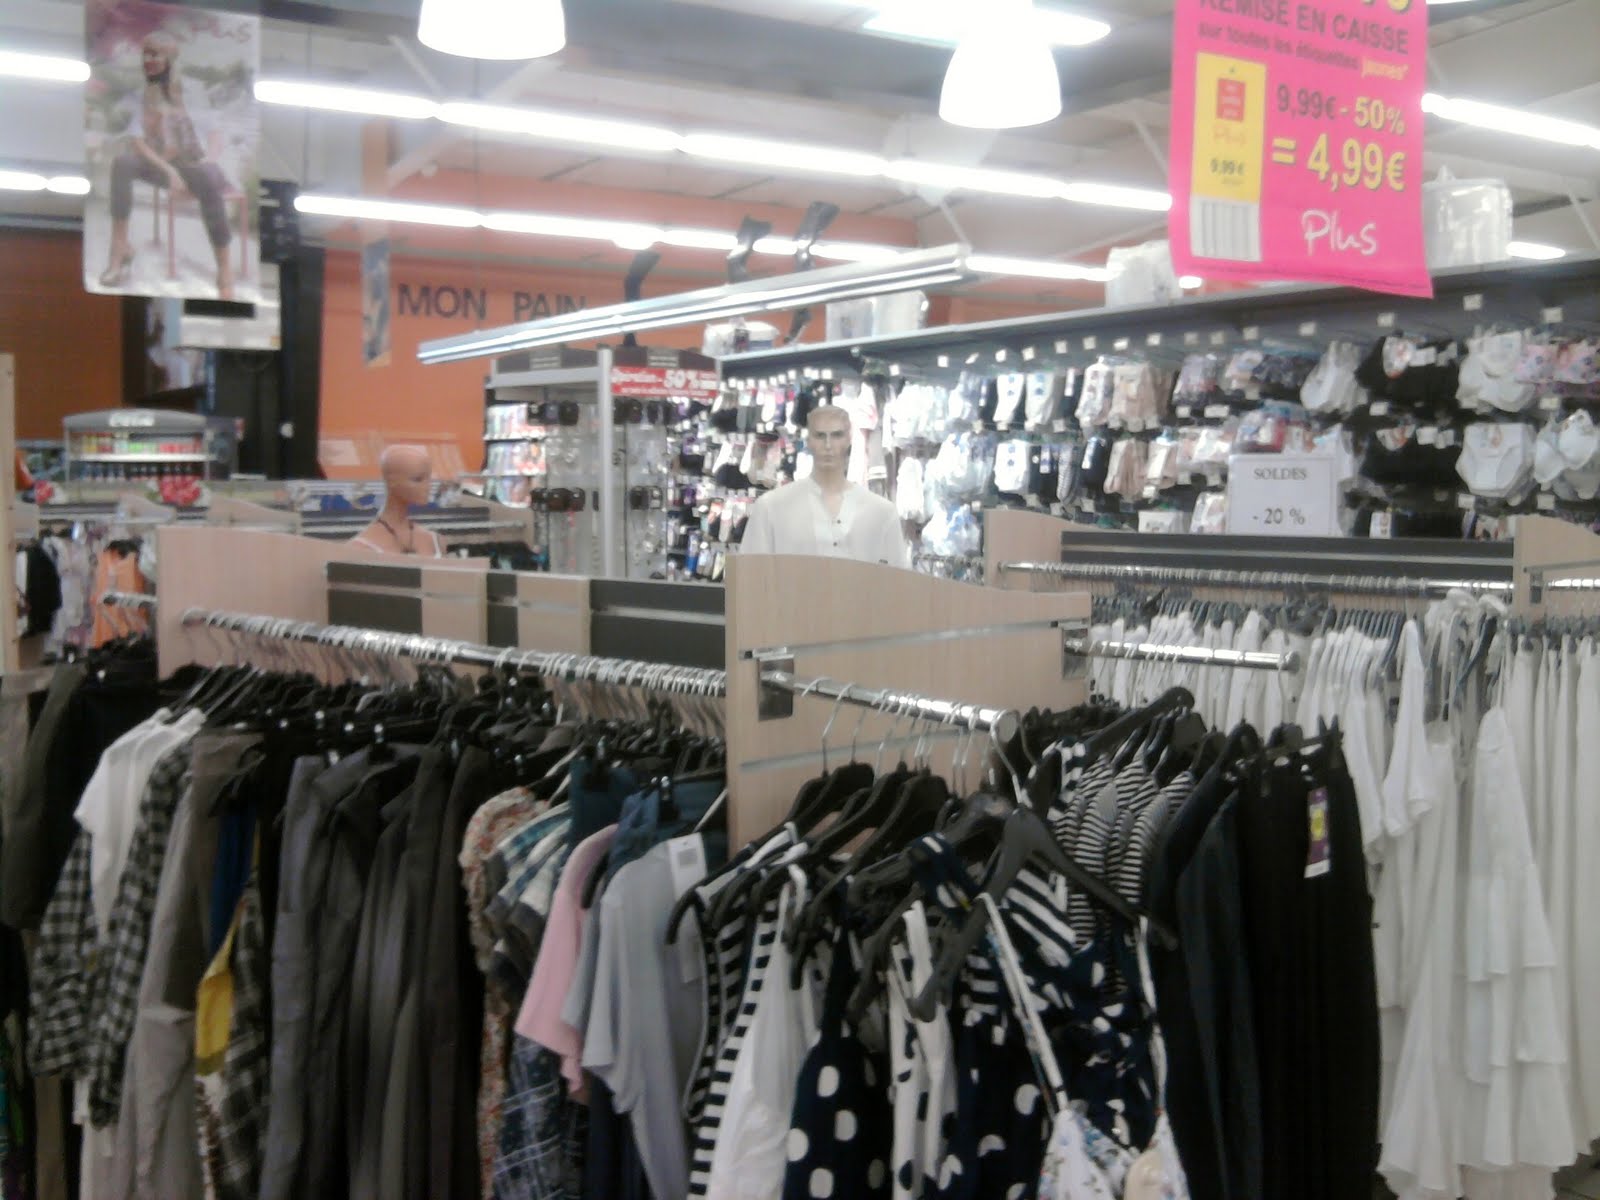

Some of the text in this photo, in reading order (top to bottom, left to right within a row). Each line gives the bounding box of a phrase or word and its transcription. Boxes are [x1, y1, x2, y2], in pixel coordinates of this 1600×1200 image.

[1296, 4, 1327, 36] EN
[1332, 13, 1409, 55] CAISSE
[1276, 83, 1337, 120] 9,99€
[1306, 132, 1406, 192] 4,99€
[1301, 208, 1377, 257] Plus
[397, 283, 488, 320] MON
[1253, 466, 1307, 480] SOLDES
